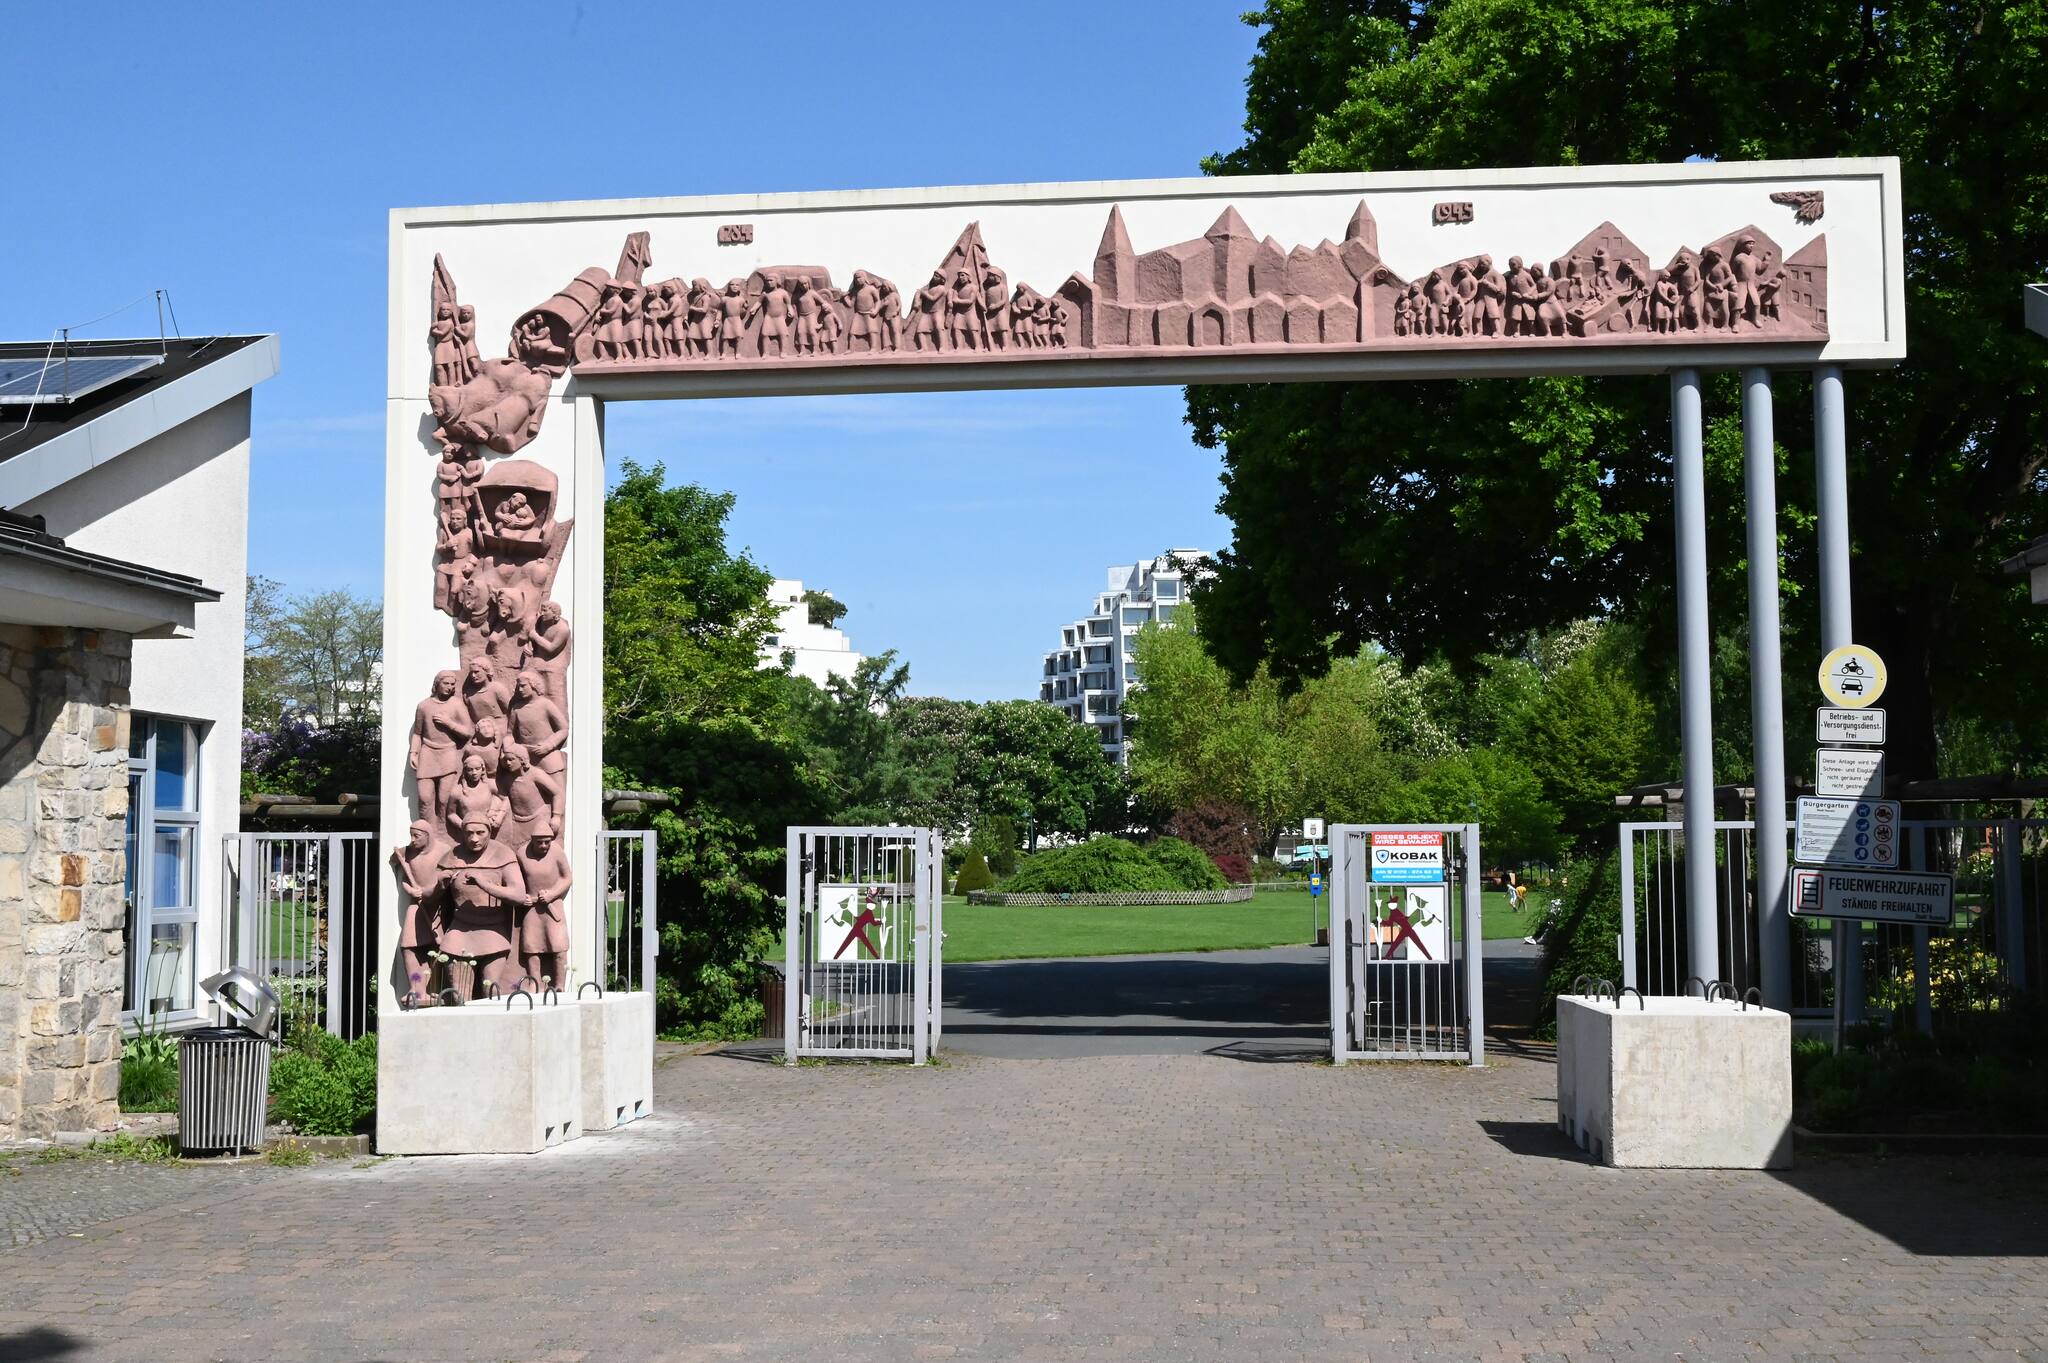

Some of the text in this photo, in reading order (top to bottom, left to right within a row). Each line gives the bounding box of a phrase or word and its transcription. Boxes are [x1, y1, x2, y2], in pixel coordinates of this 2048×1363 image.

[1829, 712, 1859, 721] Betriebs-
[1823, 721, 1880, 731] Versorgungsdienst
[1845, 731, 1857, 739] frei
[1803, 800, 1850, 809] Bürgergarten
[1828, 877, 1947, 897] FEUERWEHRZUFAHRT
[1841, 897, 1933, 913] STÄNDIG FREIHALTEN
